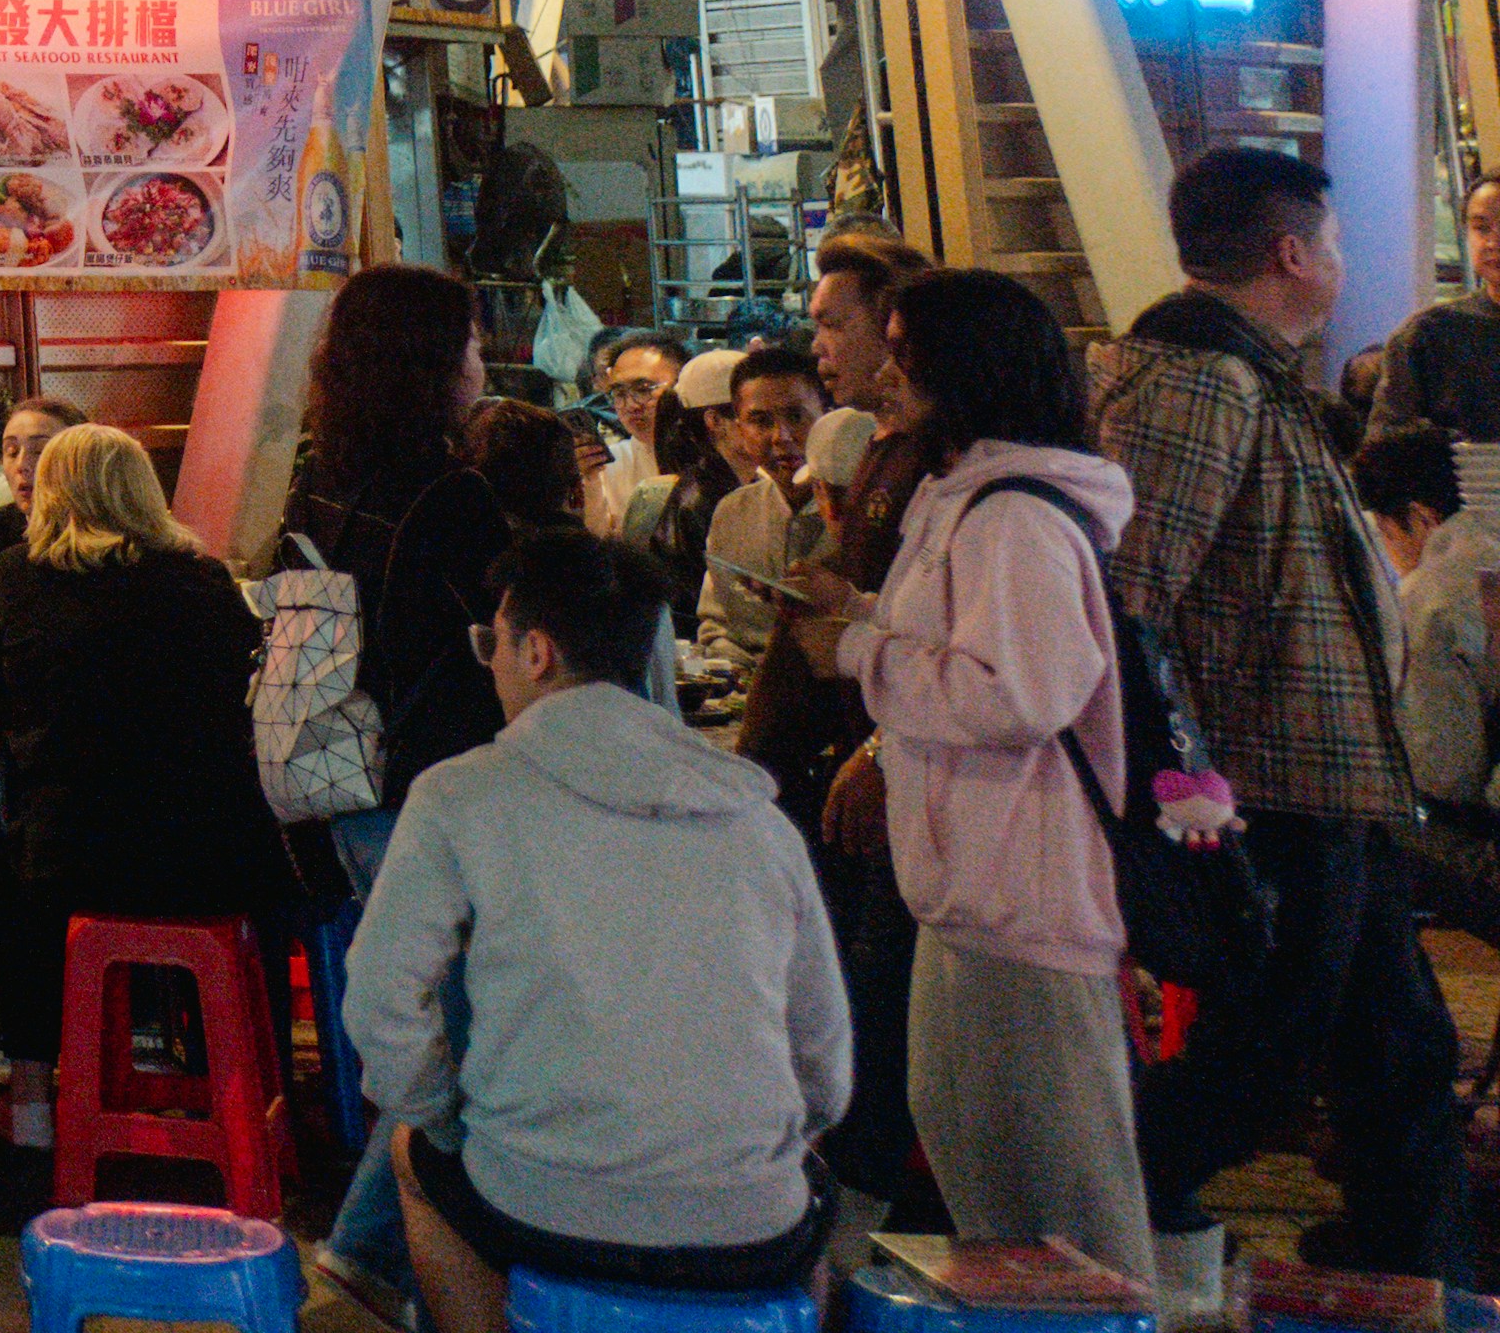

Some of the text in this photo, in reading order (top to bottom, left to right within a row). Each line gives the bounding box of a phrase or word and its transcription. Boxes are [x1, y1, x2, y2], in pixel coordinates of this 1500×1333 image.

[250, 0, 355, 17] BLUE GIRL
[14, 51, 81, 64] SEAFOOD
[87, 52, 179, 65] RESTAURANT
[266, 55, 310, 203] 咁夾先夠爽
